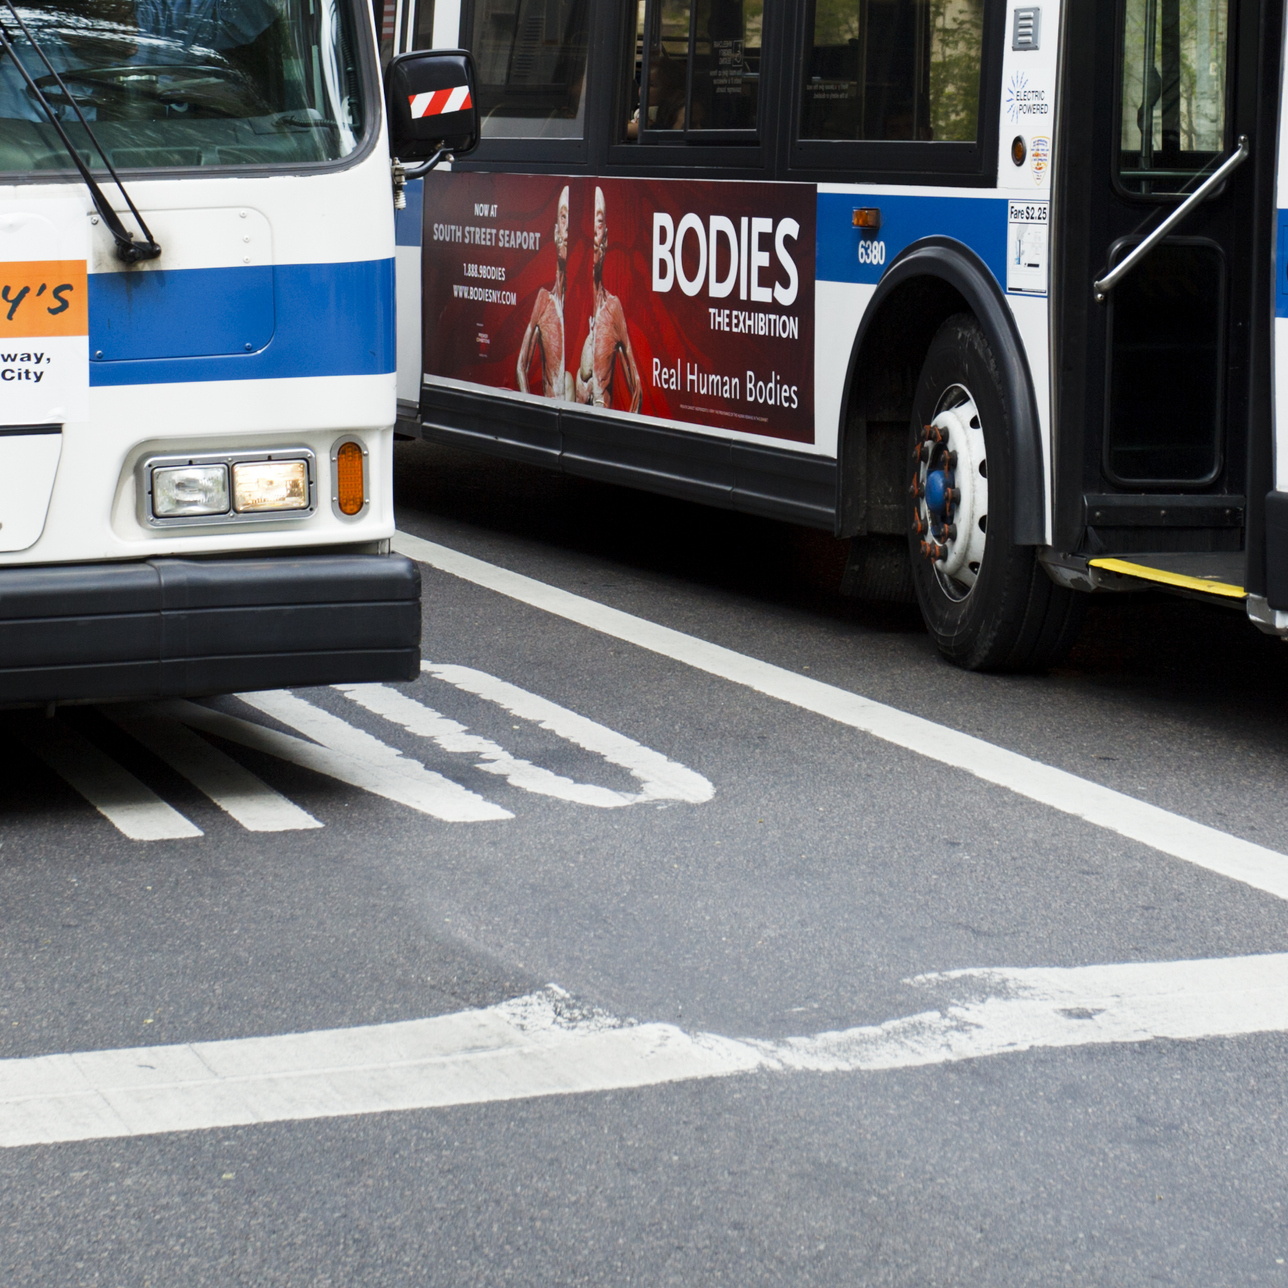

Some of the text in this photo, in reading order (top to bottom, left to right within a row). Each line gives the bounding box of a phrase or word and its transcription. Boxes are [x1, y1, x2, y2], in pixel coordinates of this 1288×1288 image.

[1015, 90, 1046, 102] ELECTRIC
[1018, 103, 1049, 115] POWERED
[474, 203, 498, 218] NOW AT
[1010, 205, 1048, 221] Fare $2.25
[433, 223, 541, 250] SOUTH STREET SEAPORT
[652, 211, 801, 307] BODIES
[858, 239, 886, 266] 6380
[463, 262, 506, 281] 1.888.9BODIES
[453, 284, 517, 306] WWW.BODIESNY.COM
[708, 307, 800, 341] THE EXHIBITION
[0, 366, 46, 386] City
[652, 357, 799, 409] Real Human Bodies
